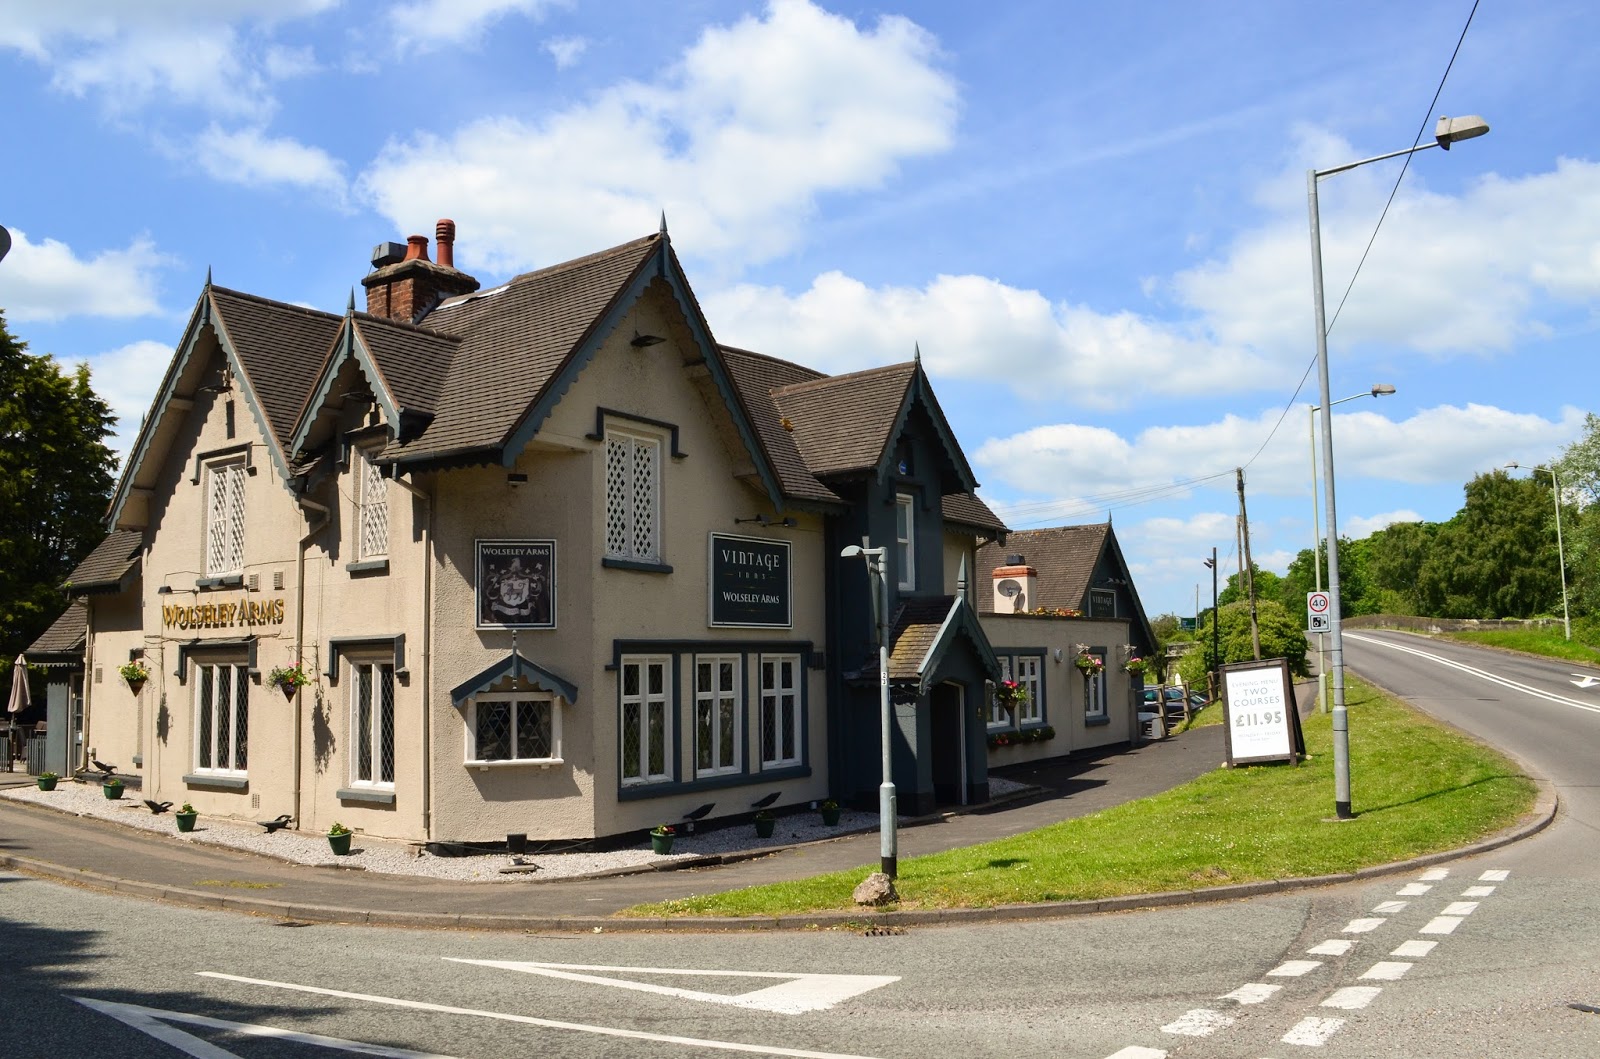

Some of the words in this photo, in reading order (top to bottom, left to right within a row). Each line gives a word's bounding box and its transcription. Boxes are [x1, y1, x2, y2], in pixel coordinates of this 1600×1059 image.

[526, 548, 549, 556] ARMS
[722, 549, 780, 571] VINTAGE
[723, 591, 760, 603] WOLSELEY
[761, 594, 780, 604] ARMS
[1312, 599, 1326, 607] 40
[162, 604, 237, 627] WOLSELEY
[237, 598, 284, 625] ARMS
[1243, 687, 1268, 696] TWO
[1233, 696, 1280, 707] COURSES
[1235, 711, 1282, 727] £11.95
